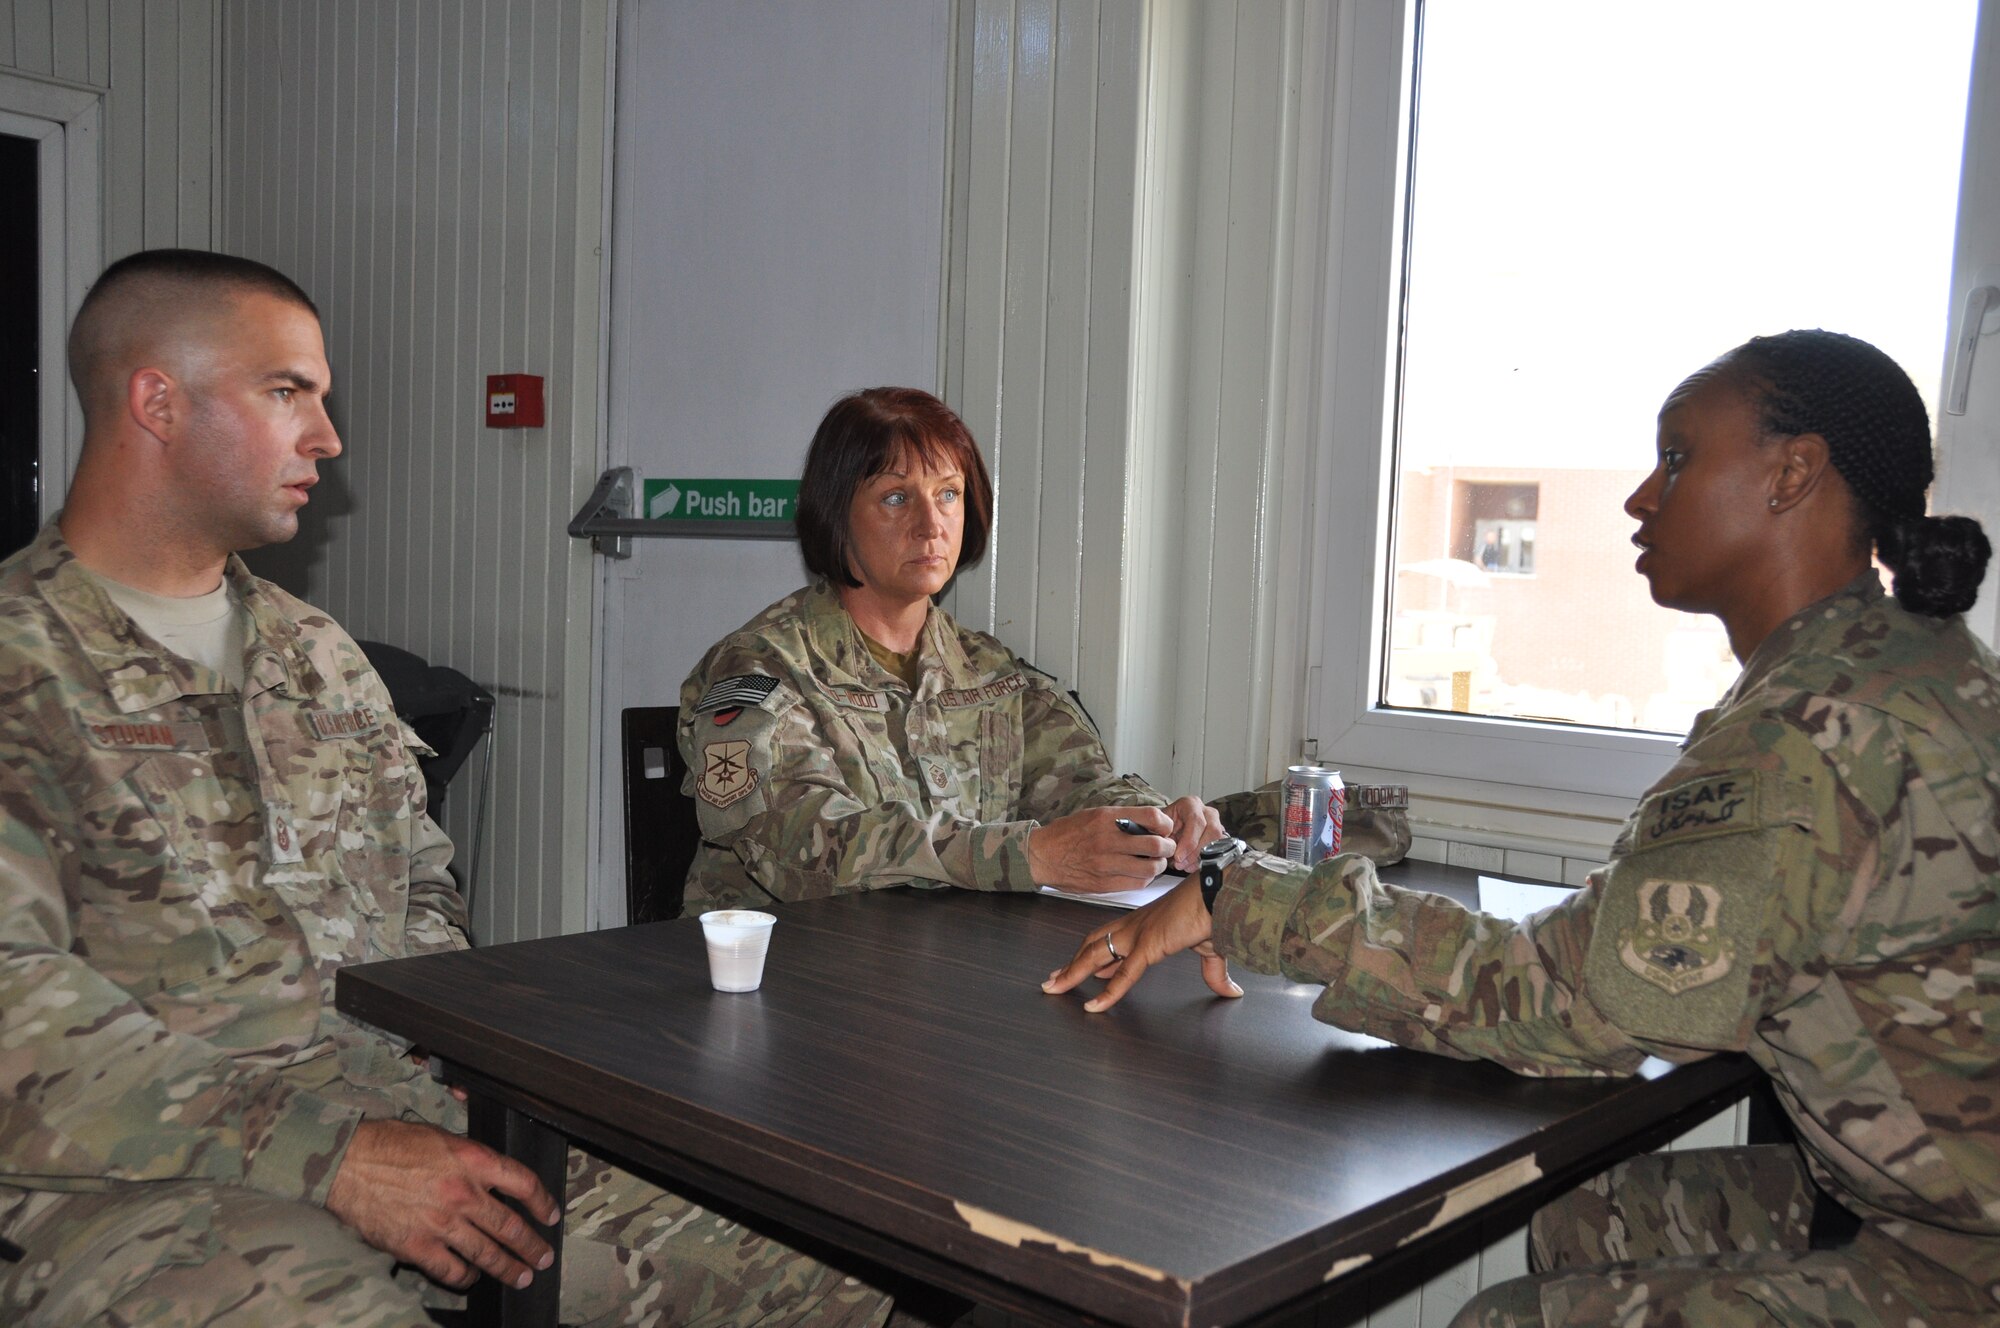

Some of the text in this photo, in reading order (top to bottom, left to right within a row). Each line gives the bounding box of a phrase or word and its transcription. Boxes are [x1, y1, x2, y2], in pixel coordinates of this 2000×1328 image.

[686, 490, 740, 516] Push
[748, 491, 788, 518] bar
[962, 688, 983, 706] AIR
[983, 672, 1026, 699] FORCE
[1661, 782, 1736, 814] ISAF
